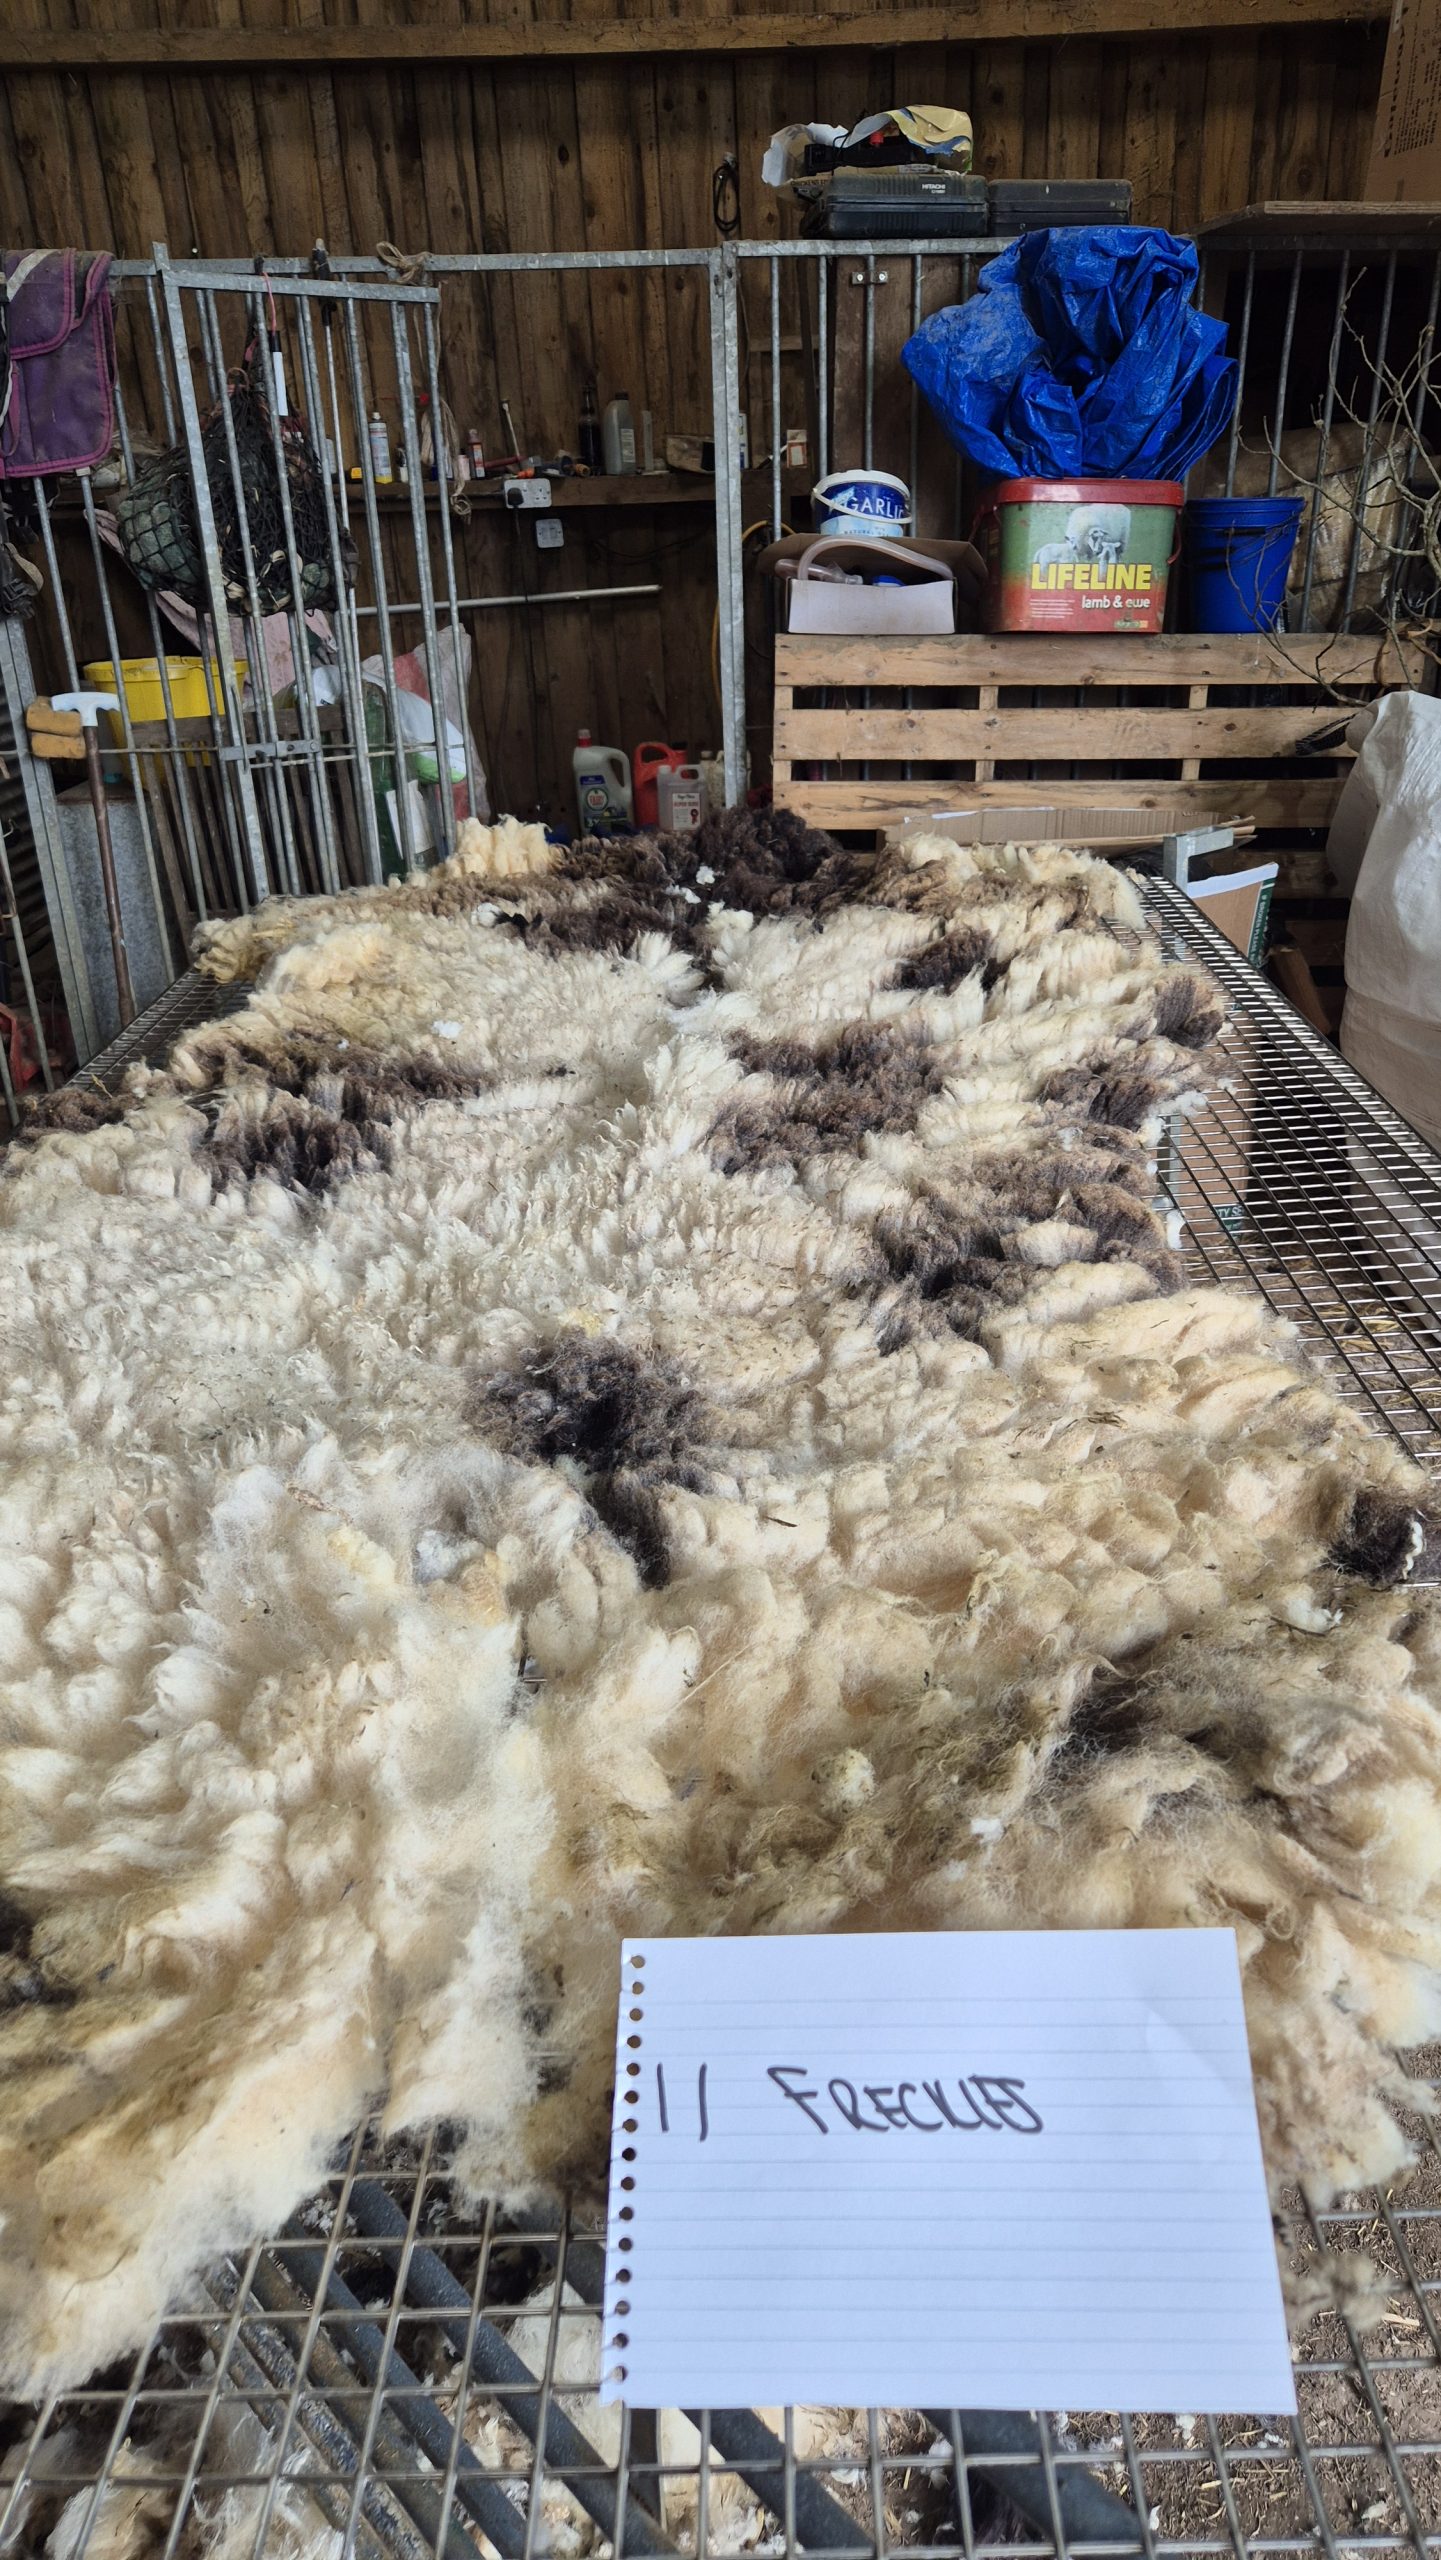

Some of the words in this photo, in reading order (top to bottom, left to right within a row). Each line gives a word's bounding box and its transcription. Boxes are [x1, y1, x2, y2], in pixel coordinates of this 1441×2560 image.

[1031, 563, 1152, 590] LIFELINE
[1082, 595, 1110, 609] lamb
[1113, 595, 1122, 608] &
[1126, 598, 1151, 608] ewe
[1256, 901, 1266, 928] BROKEN
[1251, 928, 1260, 953] PLEASE
[657, 2062, 708, 2142] 11
[767, 2066, 1043, 2134] FRECKLES
